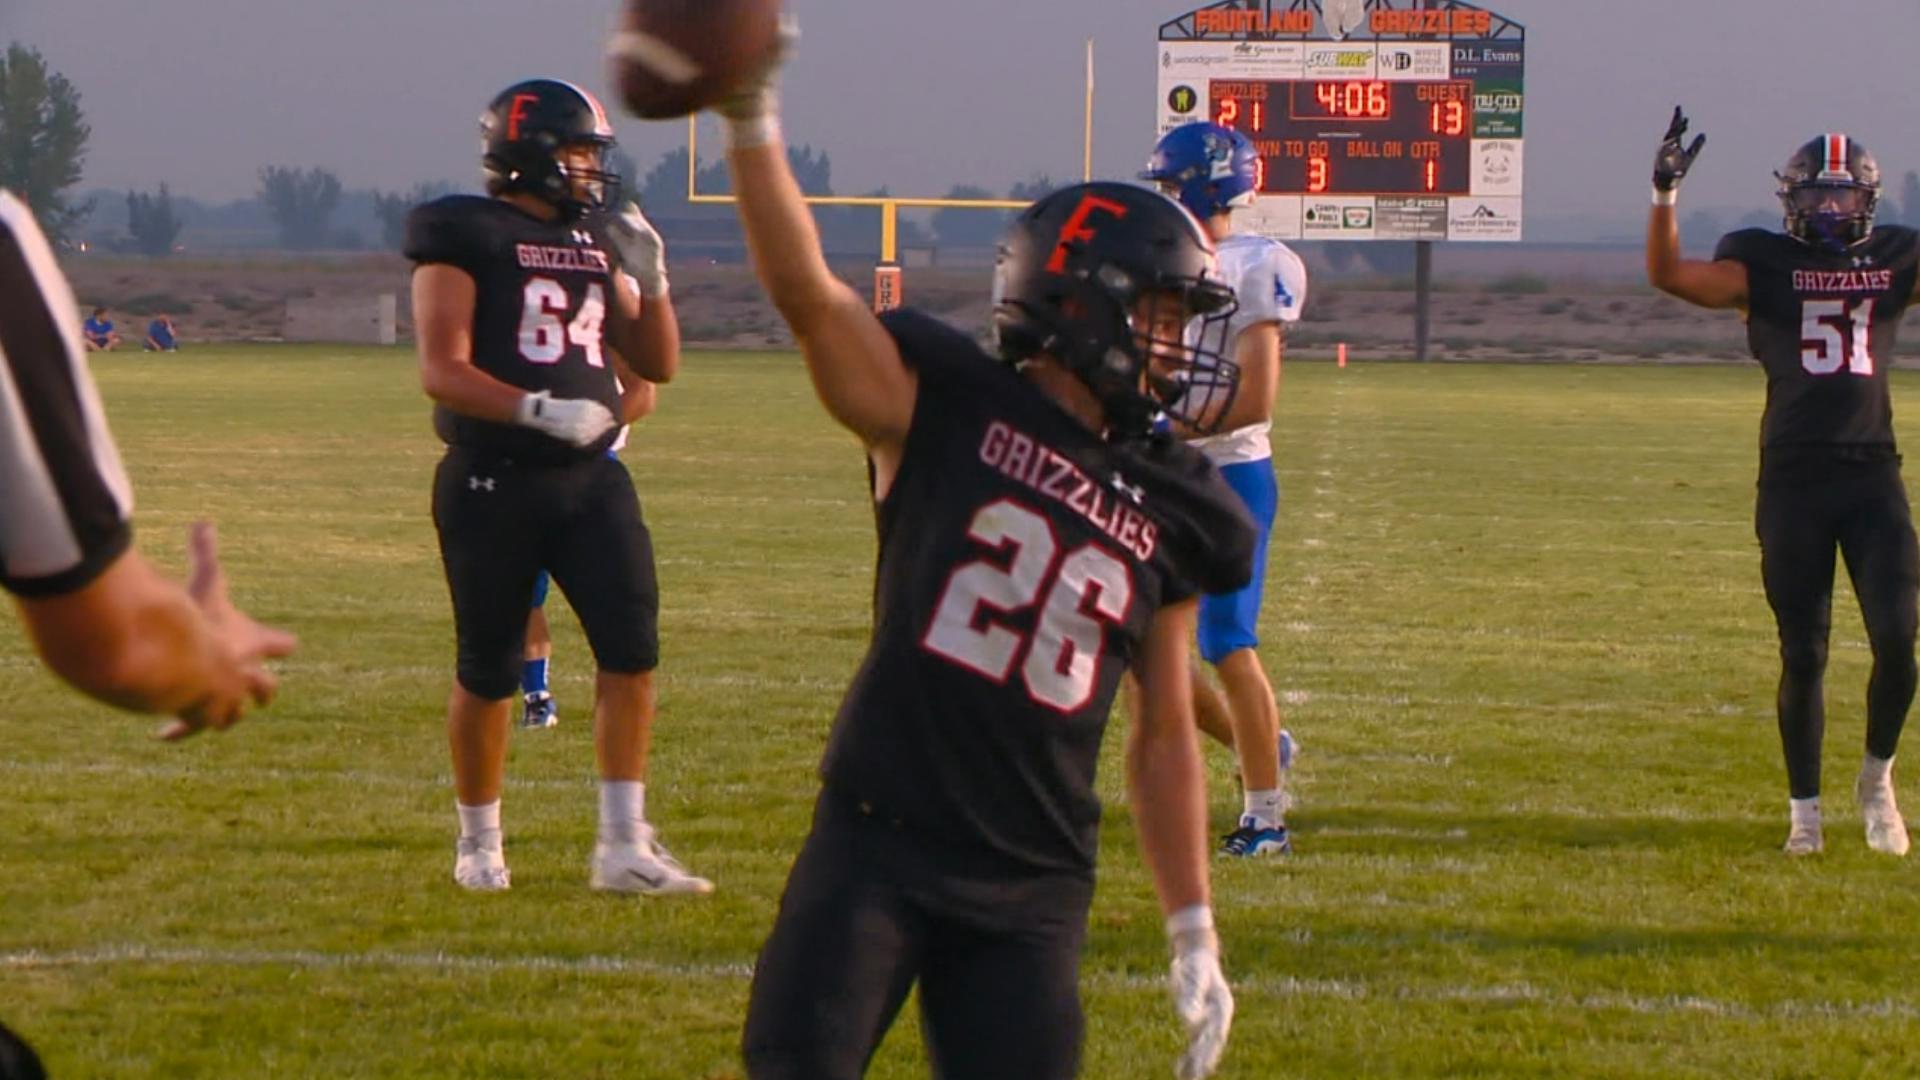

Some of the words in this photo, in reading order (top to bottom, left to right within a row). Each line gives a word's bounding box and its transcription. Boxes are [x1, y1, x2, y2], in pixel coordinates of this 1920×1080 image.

[1194, 10, 1314, 33] FRUITLAND
[1370, 9, 1491, 34] GRIZZLIES
[1306, 50, 1373, 68] SUBWAY
[1483, 48, 1520, 62] Evans
[1317, 83, 1386, 117] 4:06
[1416, 85, 1467, 101] GUEST
[507, 94, 539, 142] F
[1431, 101, 1464, 135] 13
[1255, 140, 1280, 157] WN
[1284, 140, 1303, 157] TO
[1308, 140, 1329, 158] GO
[1347, 141, 1380, 158] BALL
[1383, 141, 1402, 158] ON
[1309, 157, 1327, 192] 3
[1045, 196, 1129, 276] F
[516, 243, 608, 272] GRIZZLIES
[1792, 268, 1892, 291] GRIZZLIES
[518, 276, 606, 370] 64
[1799, 297, 1876, 377] 51
[979, 420, 1158, 564] GRIZZLIES
[921, 497, 1134, 716] 26
